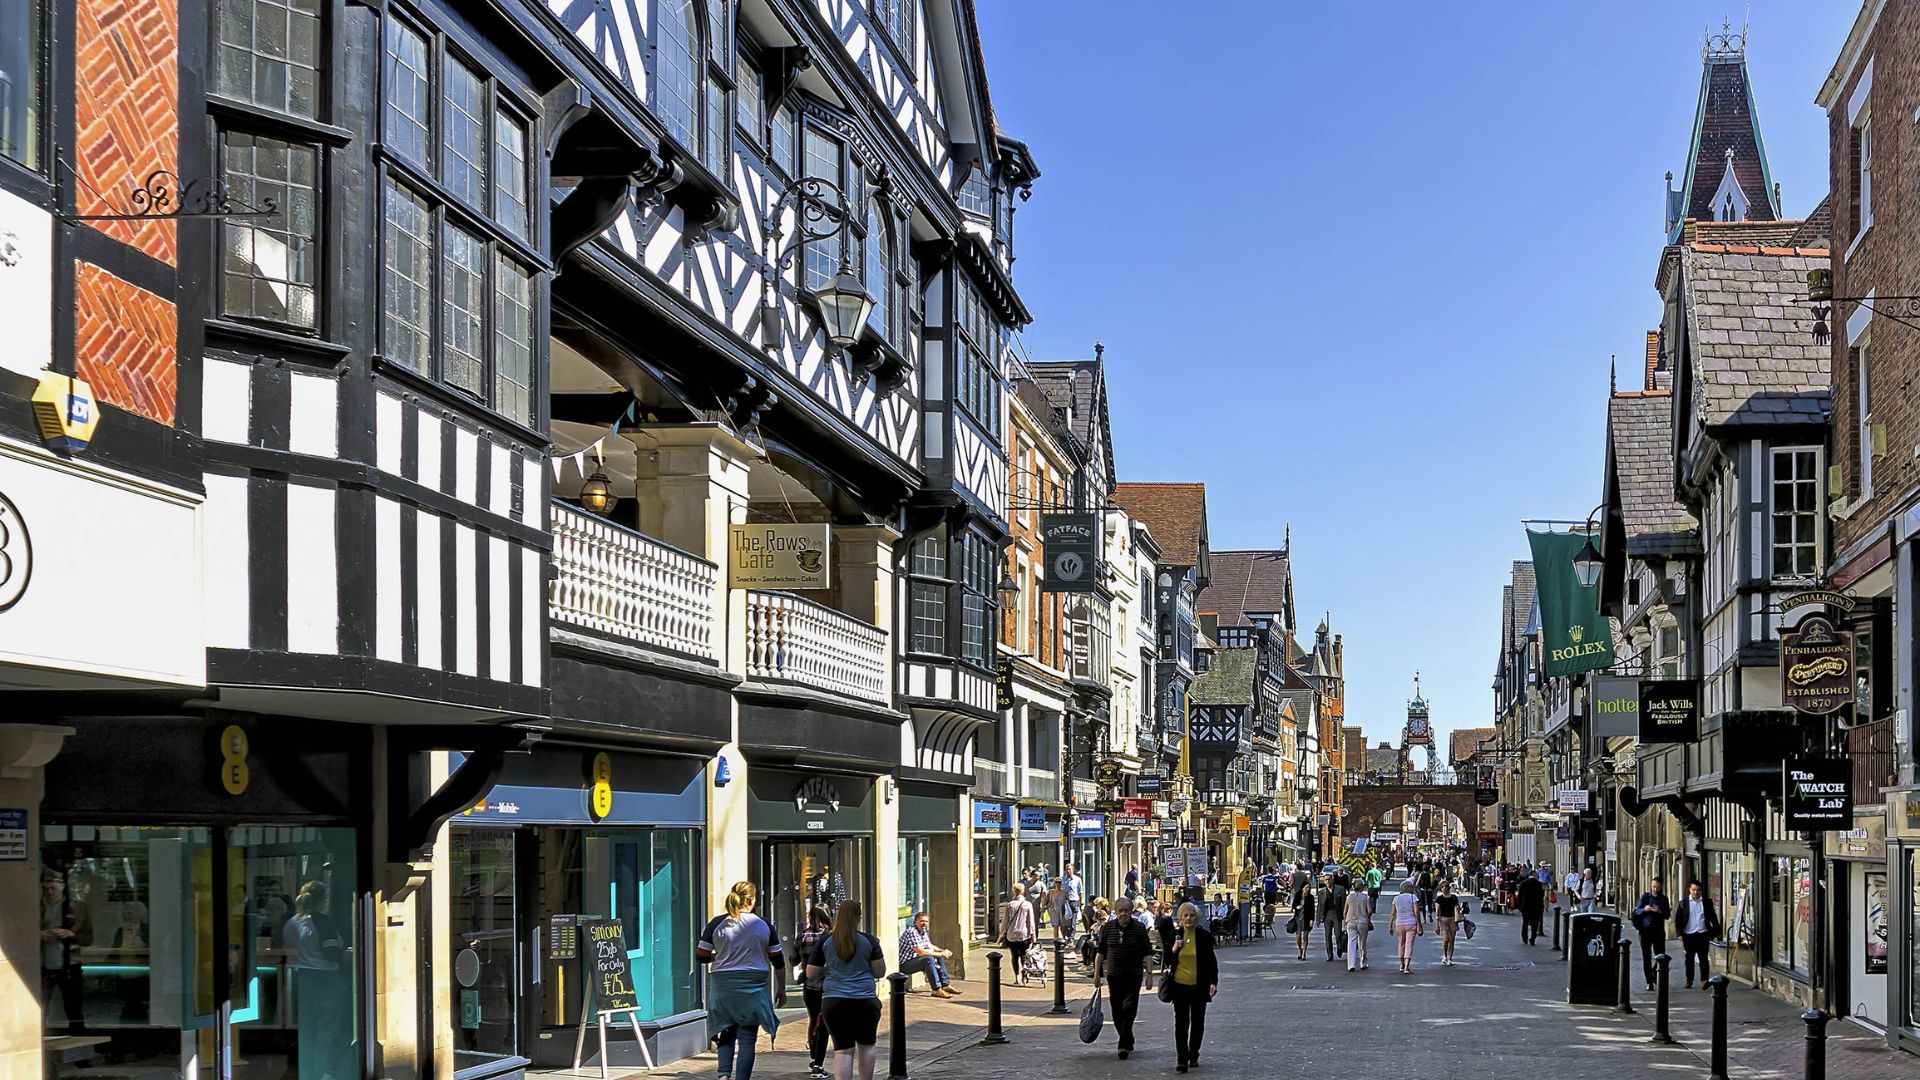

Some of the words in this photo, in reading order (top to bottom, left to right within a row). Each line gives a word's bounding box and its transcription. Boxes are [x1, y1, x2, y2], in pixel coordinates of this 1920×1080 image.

[1047, 525, 1091, 537] FATFACE
[733, 530, 760, 551] The
[766, 530, 807, 551] Rows
[739, 546, 774, 569] Café
[1782, 594, 1852, 609] PENHALIGON'S
[1551, 640, 1607, 661] ROLEX
[1784, 644, 1851, 655] PENHALIGON'S
[1795, 661, 1842, 679] PERFUMERS
[1787, 687, 1850, 696] ESTABLISHED
[1646, 699, 1667, 713] Jack
[1669, 699, 1694, 709] Wills
[1807, 698, 1831, 708] 1870
[1790, 770, 1815, 780] The
[1799, 783, 1845, 793] WATCH
[597, 959, 609, 972] For
[609, 958, 625, 975] Only
